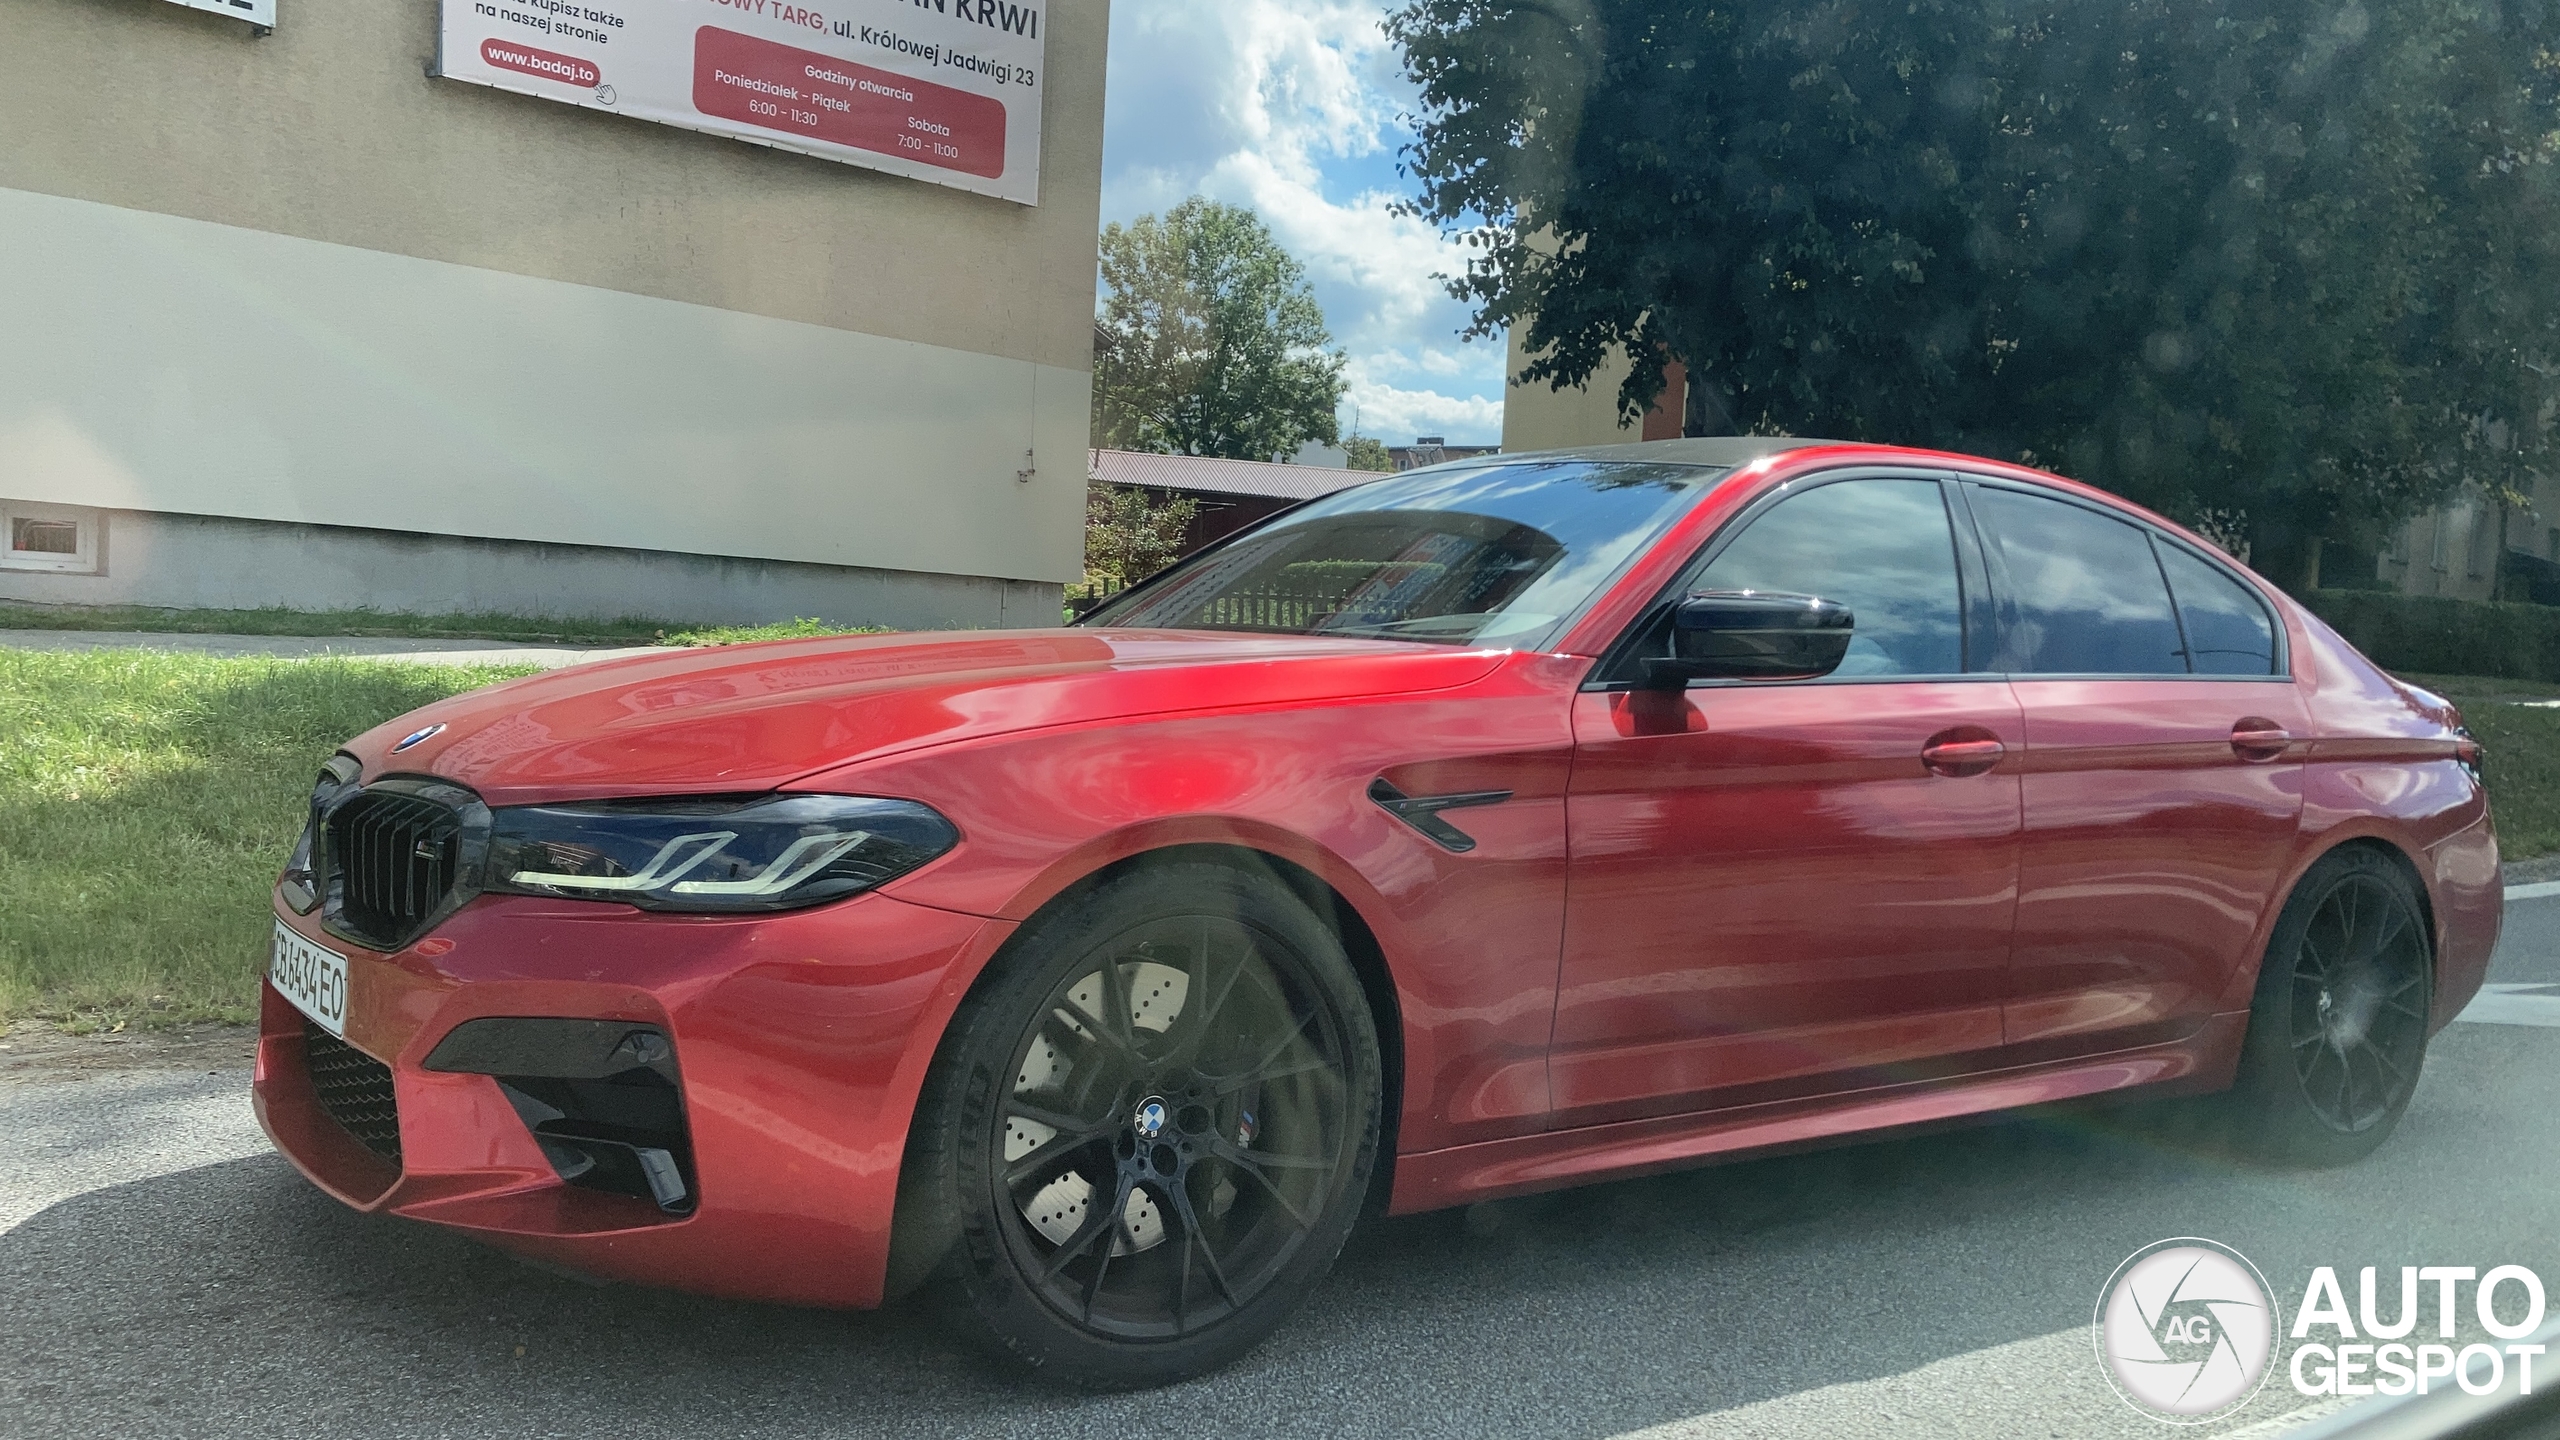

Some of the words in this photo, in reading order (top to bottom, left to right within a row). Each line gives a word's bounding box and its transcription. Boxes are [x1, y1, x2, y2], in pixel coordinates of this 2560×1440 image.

[475, 2, 496, 17] na
[500, 8, 551, 34] naszej
[555, 21, 608, 44] stronie
[584, 7, 624, 28] także
[956, 0, 1037, 39] KRWI
[771, 1, 828, 35] TARG,
[834, 20, 855, 39] ul.
[860, 25, 939, 67] Królowej
[943, 49, 1011, 84] Jadwigi
[1015, 67, 1034, 87] 23
[488, 46, 594, 81] www.badaj.to
[715, 69, 799, 100] Poniedziałek
[812, 93, 851, 113] Piątek
[804, 65, 856, 91] Godziny
[859, 79, 914, 102] otwarcia
[749, 99, 777, 117] 6:00
[791, 108, 818, 126] 11:30
[907, 116, 950, 136] Sobota
[897, 133, 922, 150] 7:00
[934, 142, 959, 158] 11:00
